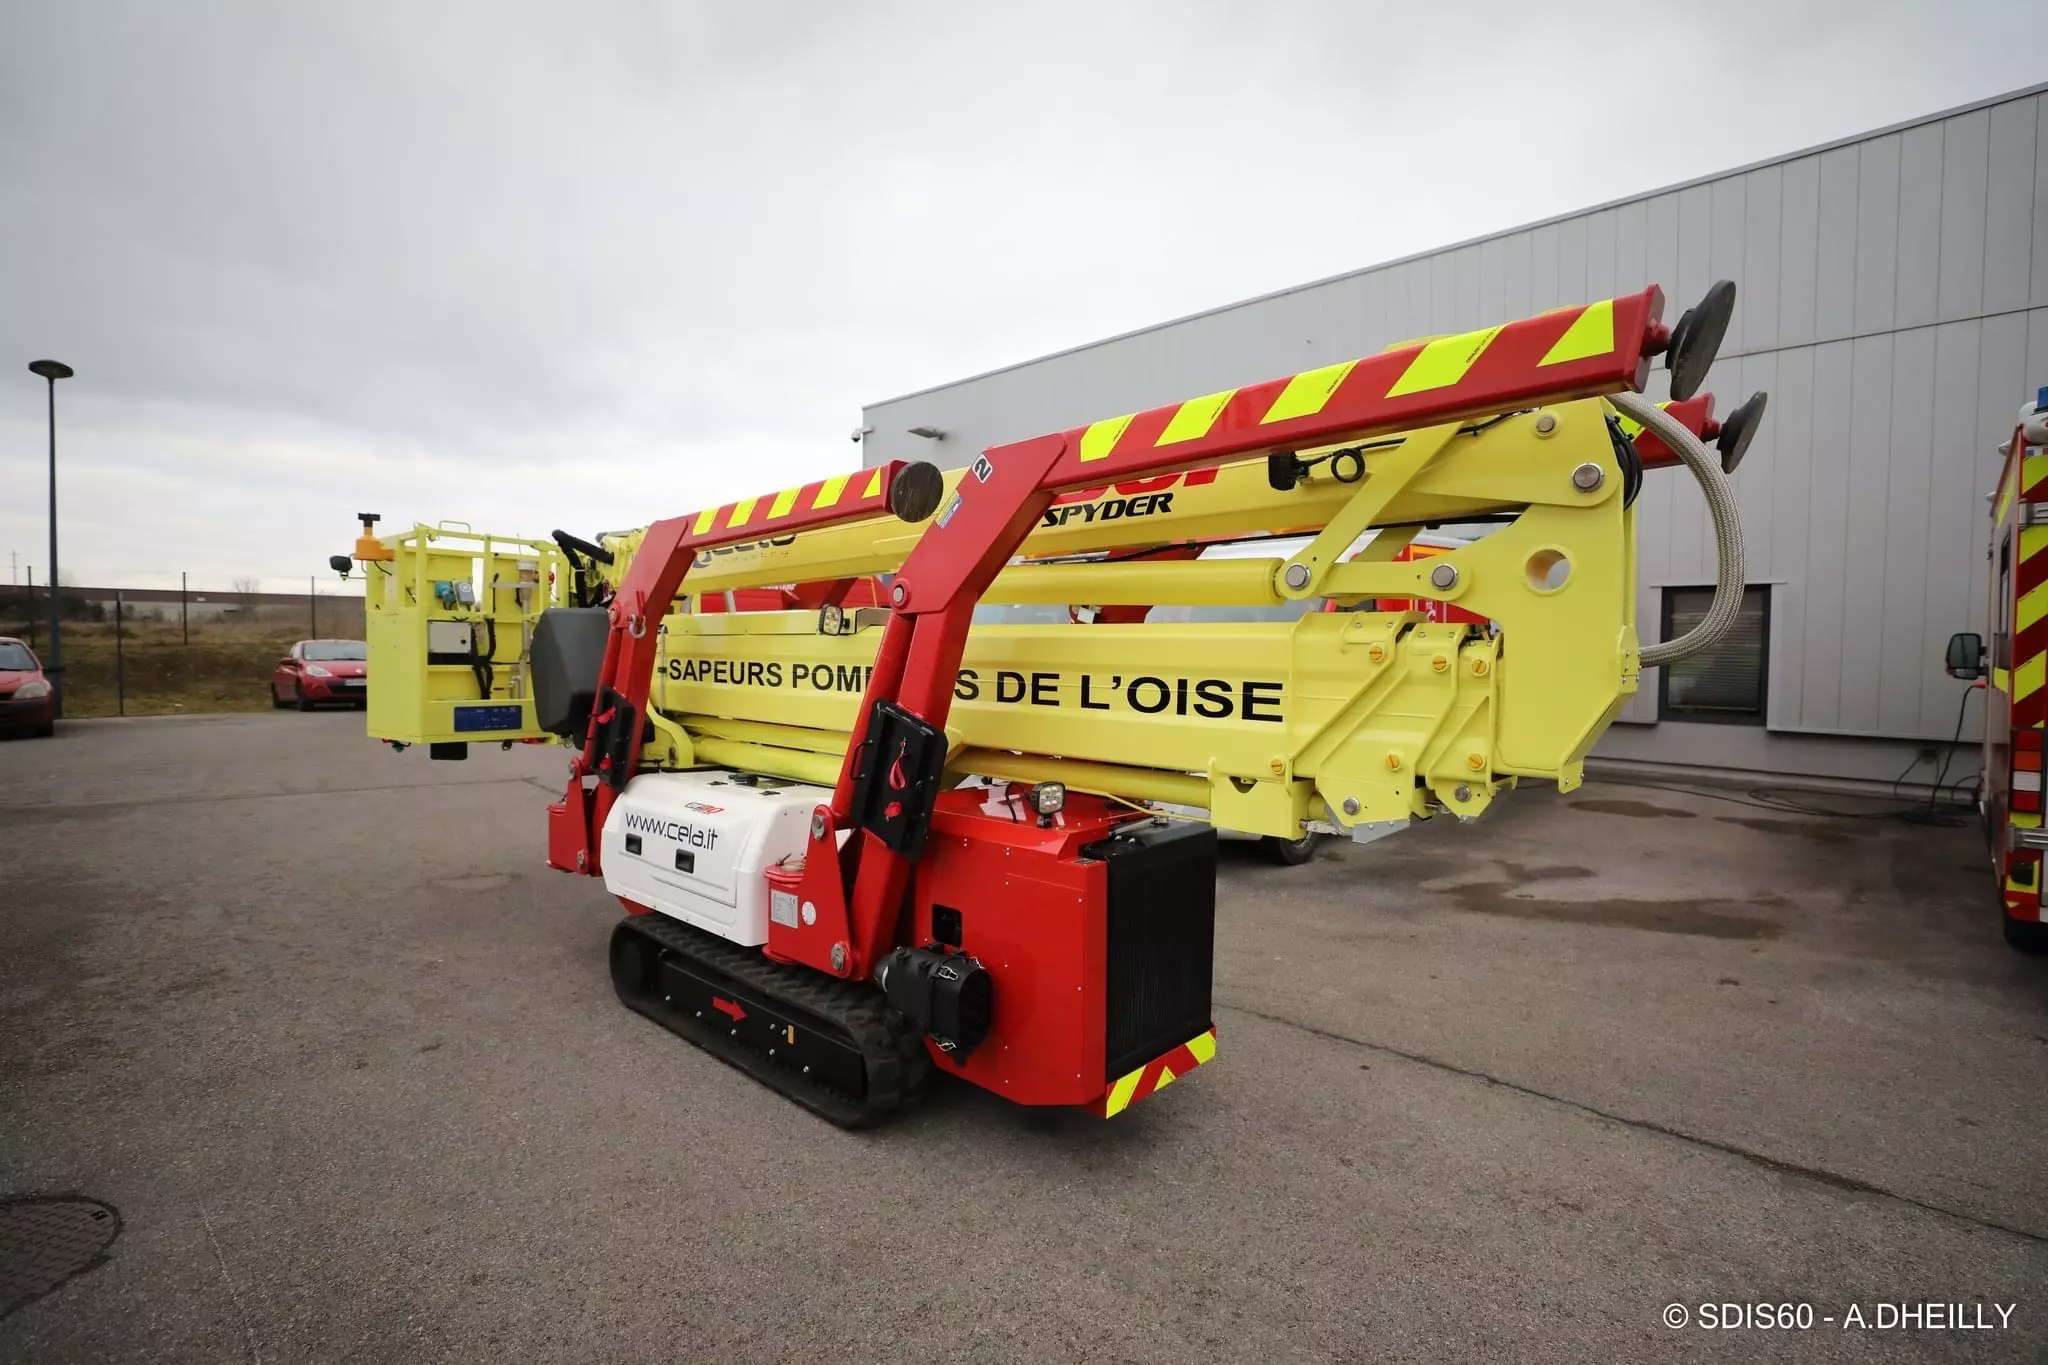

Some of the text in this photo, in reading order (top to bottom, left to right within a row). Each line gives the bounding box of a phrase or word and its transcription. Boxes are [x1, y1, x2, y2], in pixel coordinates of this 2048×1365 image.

[974, 458, 991, 481] 2
[1040, 492, 1174, 528] SPYDER
[669, 659, 783, 688] SAPEURS
[996, 671, 1060, 707] DE
[1080, 674, 1284, 723] L’OISE
[625, 811, 719, 851] www.cela.it
